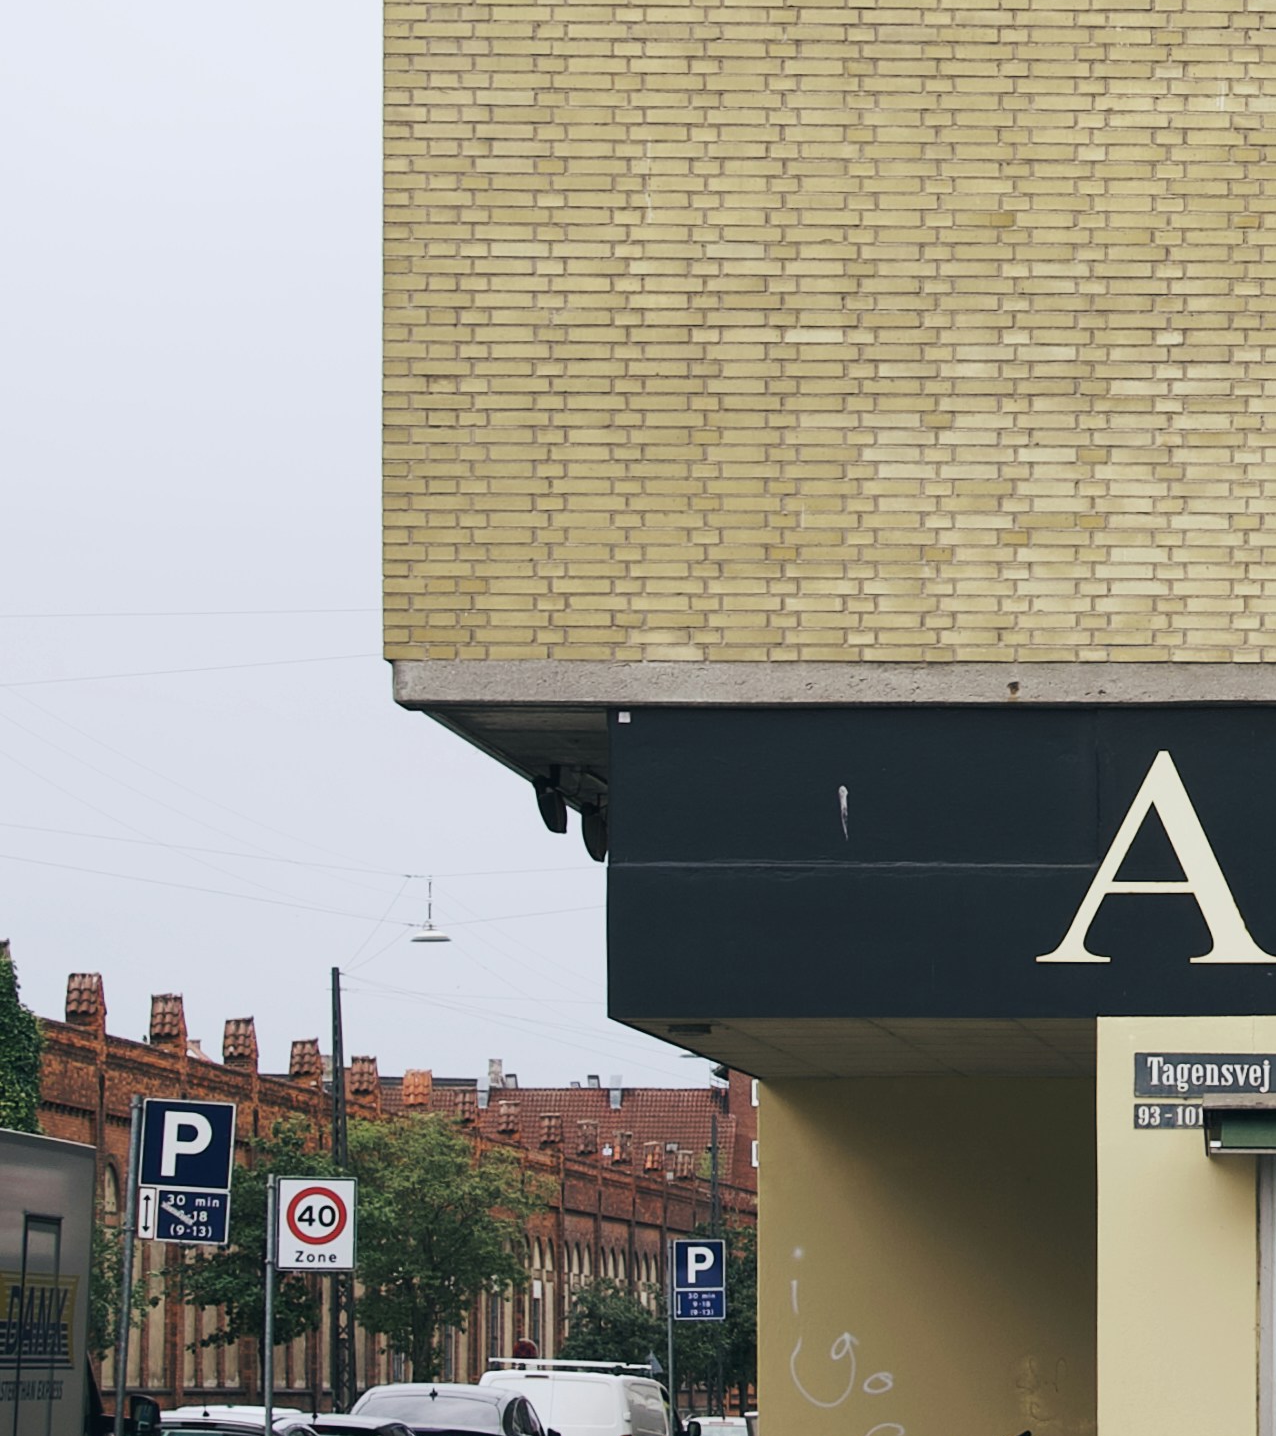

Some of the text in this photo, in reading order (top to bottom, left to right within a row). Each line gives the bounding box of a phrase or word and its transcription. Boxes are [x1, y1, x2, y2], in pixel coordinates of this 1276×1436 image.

[1147, 1056, 1271, 1093] Tagensvej
[161, 1110, 213, 1177] P
[167, 1194, 220, 1208] 30 min
[297, 1205, 337, 1227] 40
[170, 1225, 213, 1238] (9-13)
[294, 1250, 337, 1263] Zone
[687, 1246, 715, 1284] P
